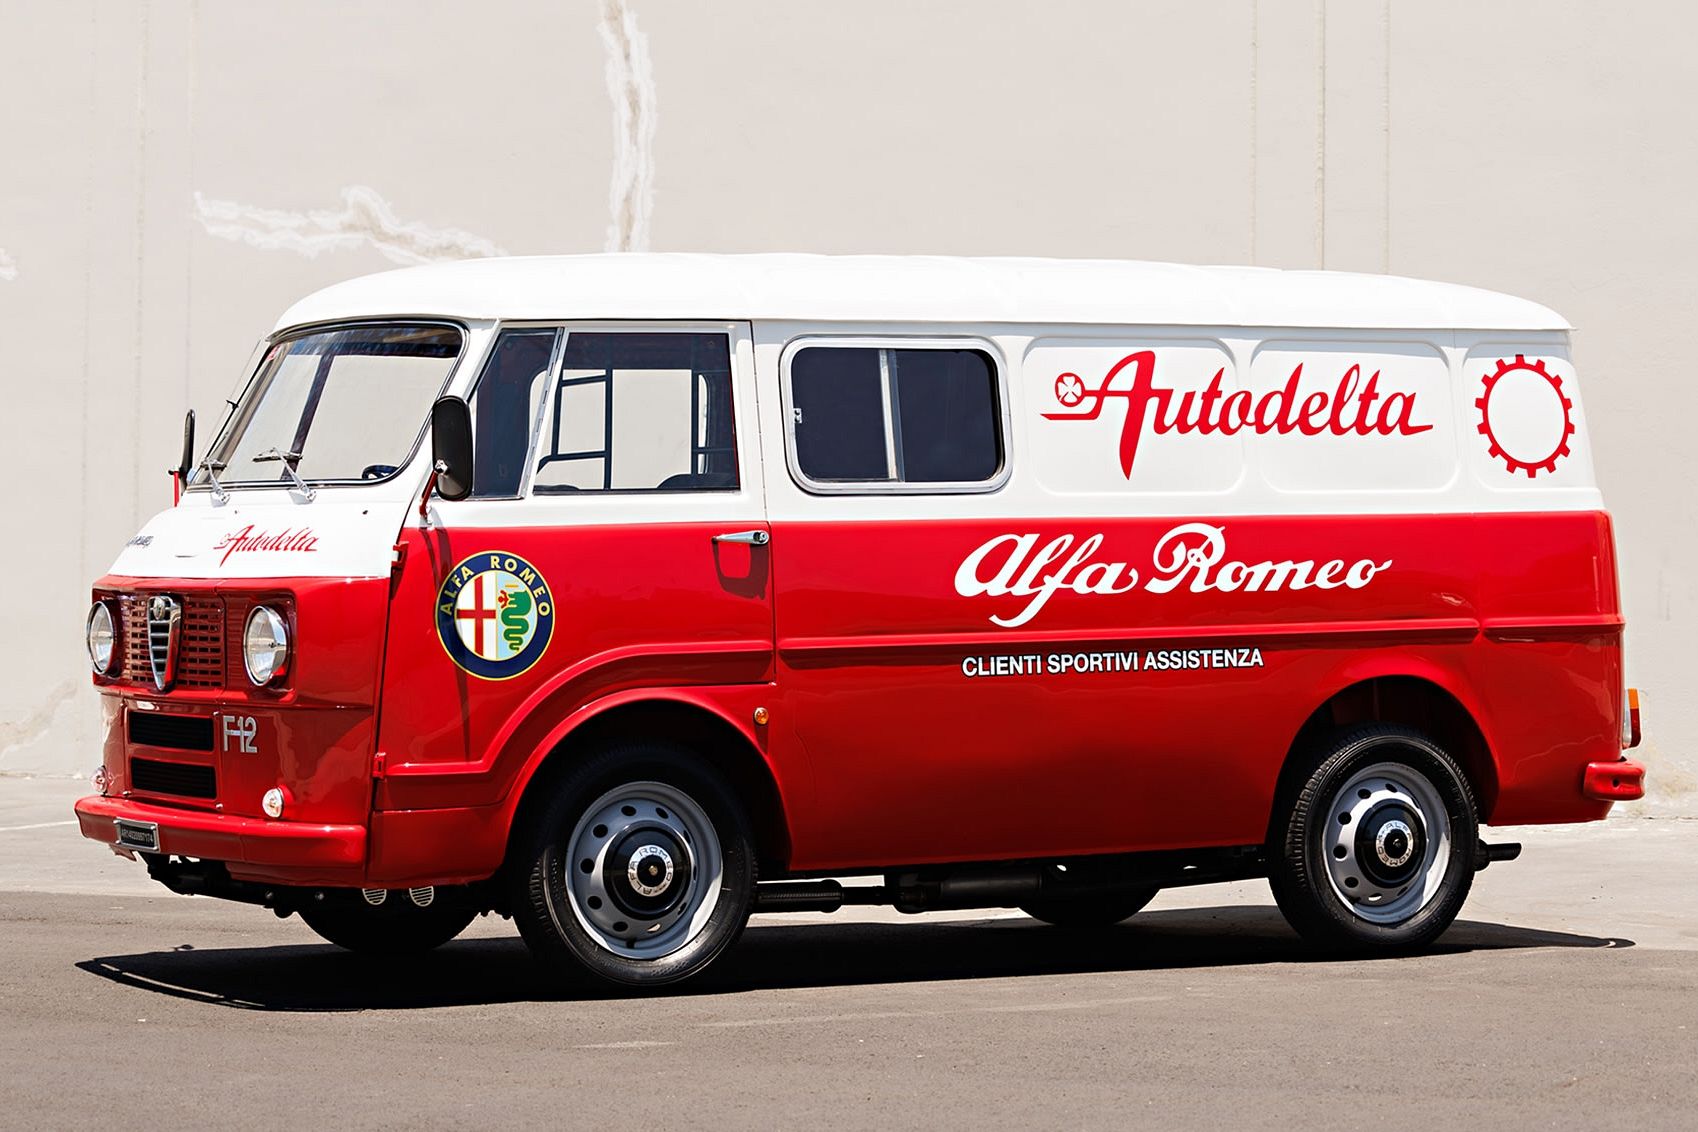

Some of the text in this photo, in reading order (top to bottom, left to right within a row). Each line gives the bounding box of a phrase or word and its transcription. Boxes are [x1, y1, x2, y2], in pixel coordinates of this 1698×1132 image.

[1041, 351, 1433, 480] Autodelta
[213, 524, 319, 567] Autodelta
[440, 555, 551, 616] ALFA ROMEO
[954, 522, 1393, 628] Alfa Romeo
[961, 648, 1265, 677] CLIENTI SPORTIVI ASSISTENZA
[223, 715, 257, 753] F12
[629, 846, 673, 895] ALFA ROMEO
